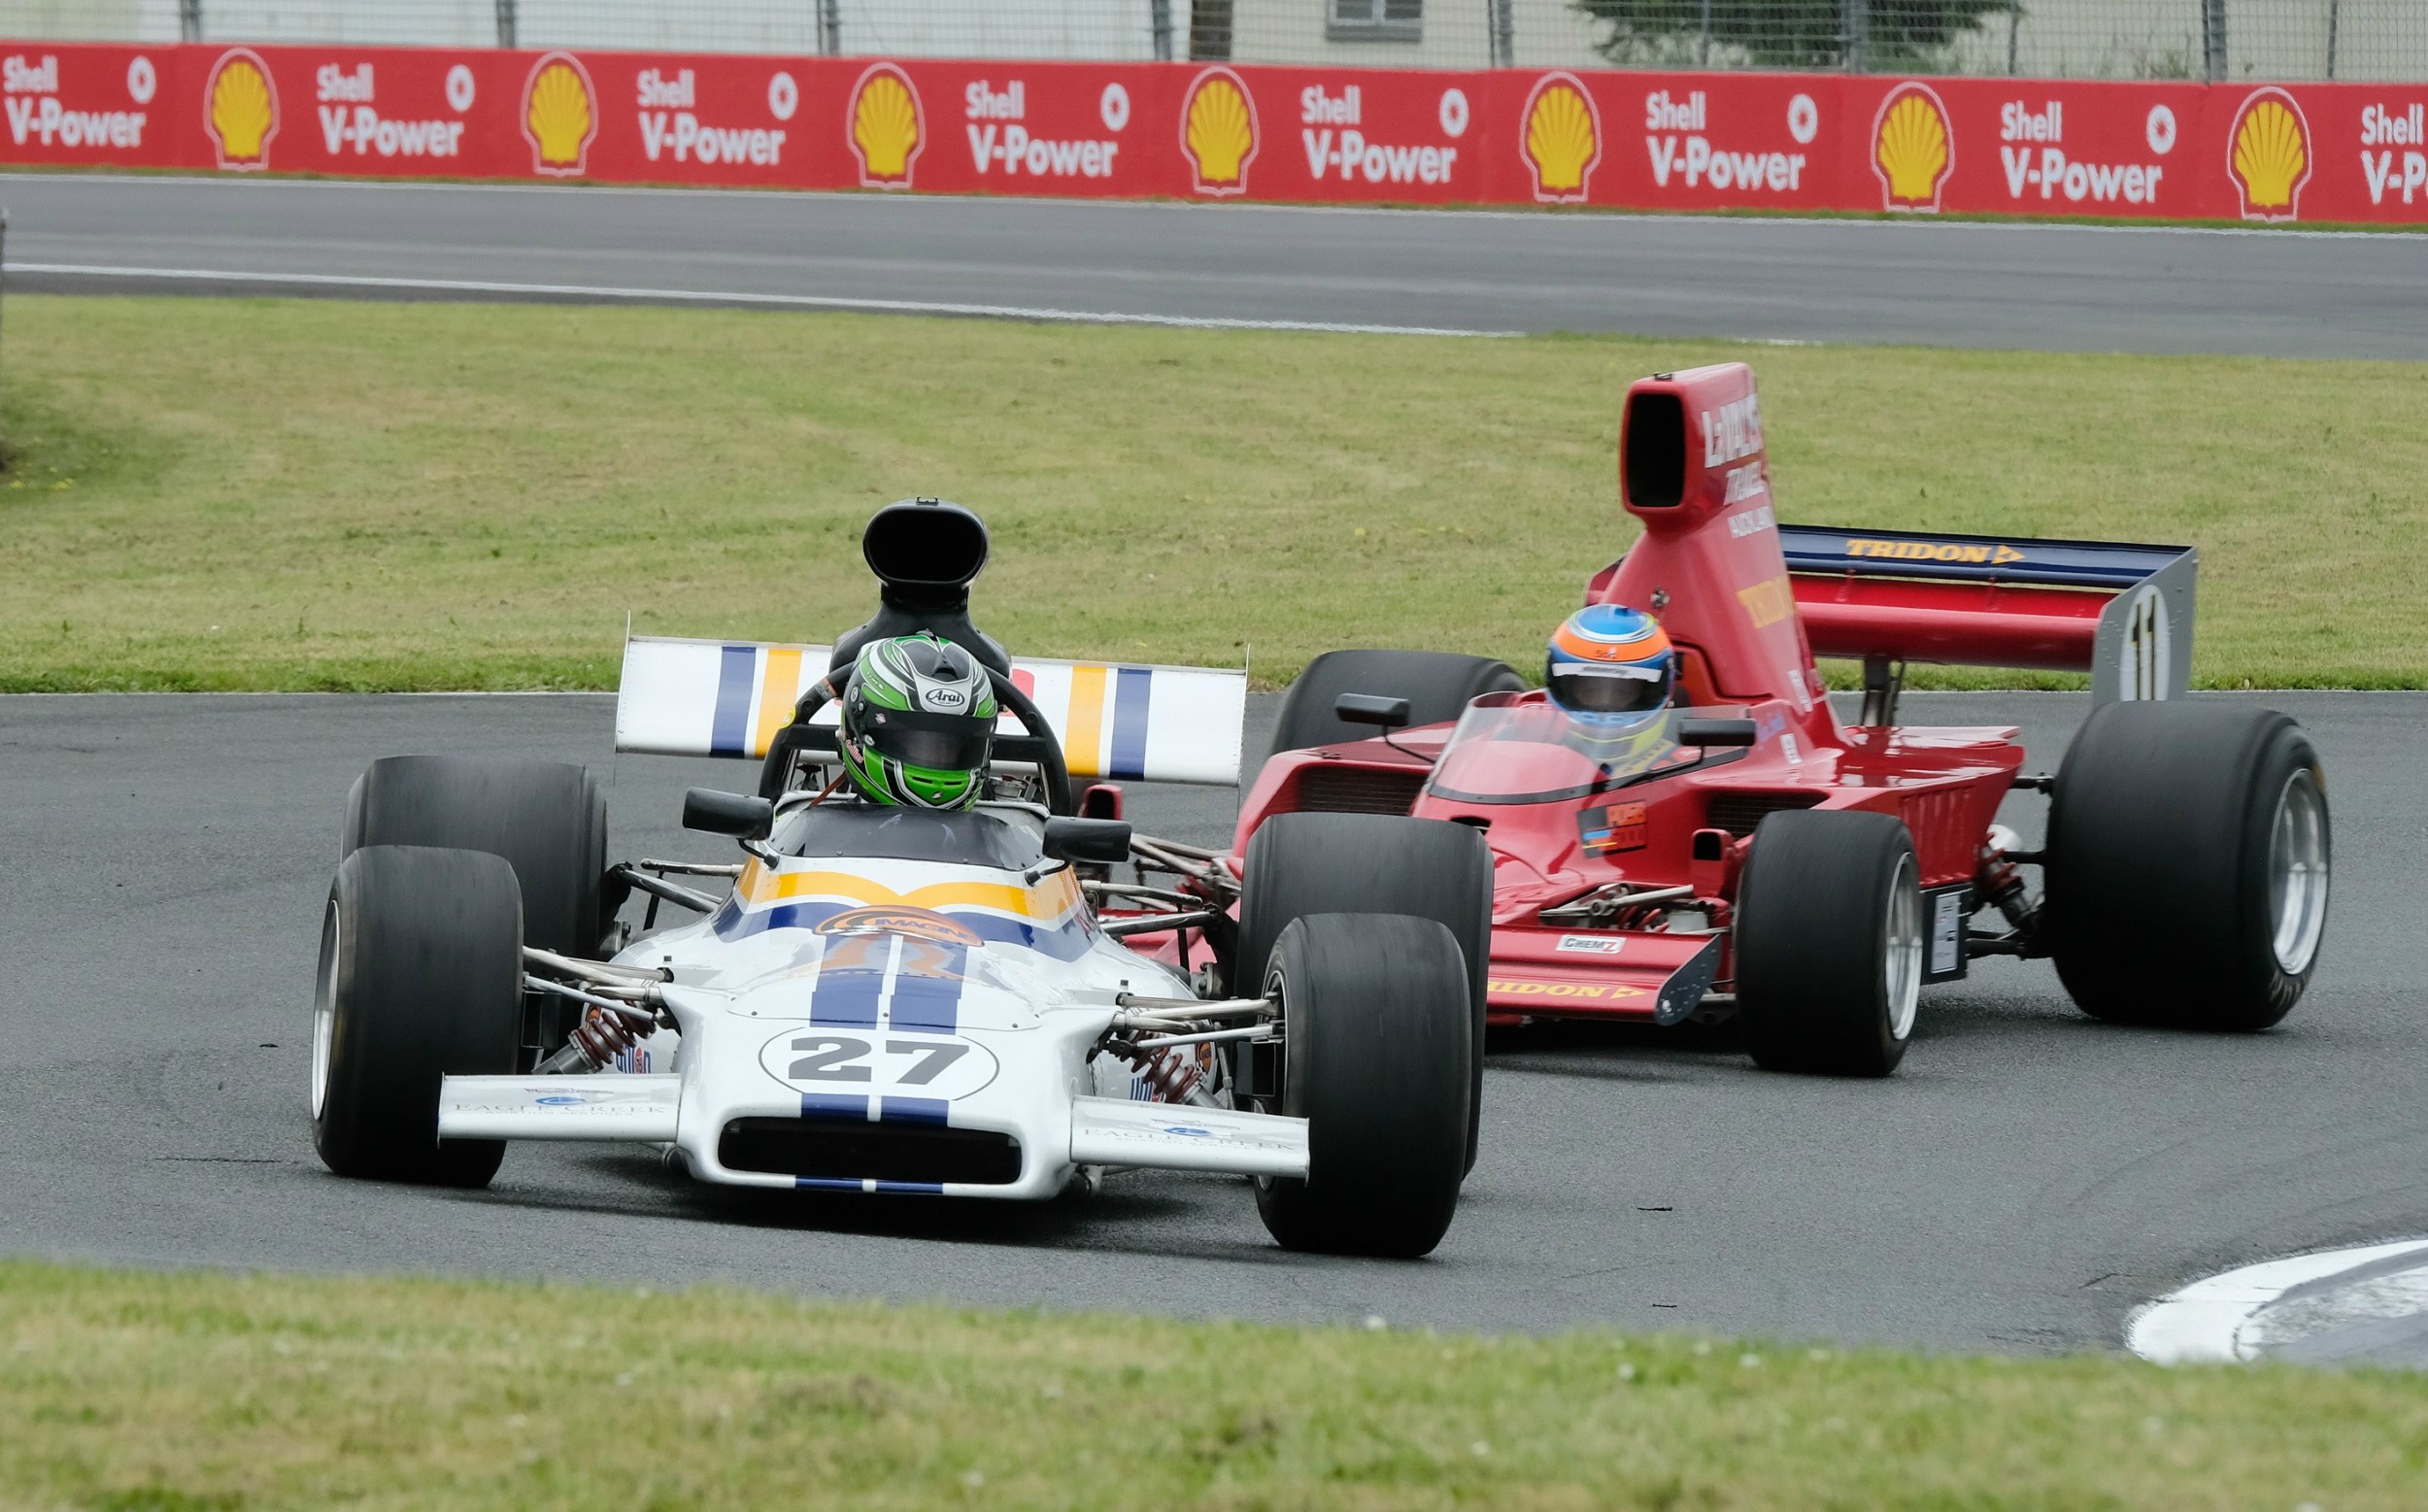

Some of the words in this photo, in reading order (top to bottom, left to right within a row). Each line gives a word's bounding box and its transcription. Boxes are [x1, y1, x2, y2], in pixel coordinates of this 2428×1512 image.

[3, 56, 58, 92] Shell
[317, 63, 374, 102] Shell
[637, 68, 694, 108] Shell
[965, 80, 1025, 119] Shell
[1301, 84, 1361, 124] Shell
[1645, 90, 1706, 131] Shell
[2000, 100, 2062, 142] Shell
[4, 97, 146, 147] V-Power
[319, 106, 464, 156] V-Power
[638, 113, 786, 165] V-Power
[2360, 103, 2424, 146] Shell
[966, 124, 1118, 177] V-Power
[1301, 129, 1457, 184] V-Power
[1646, 136, 1805, 191] V-Power
[2001, 146, 2163, 203] V-Power
[2360, 150, 2428, 204] V-P
[1846, 539, 1992, 562] TRIDON
[2131, 593, 2156, 700] 11
[929, 689, 961, 702] Arai
[789, 1036, 970, 1086] 27
[1084, 1128, 1183, 1140] EAGLE
[1194, 1137, 1295, 1150] CREEK
